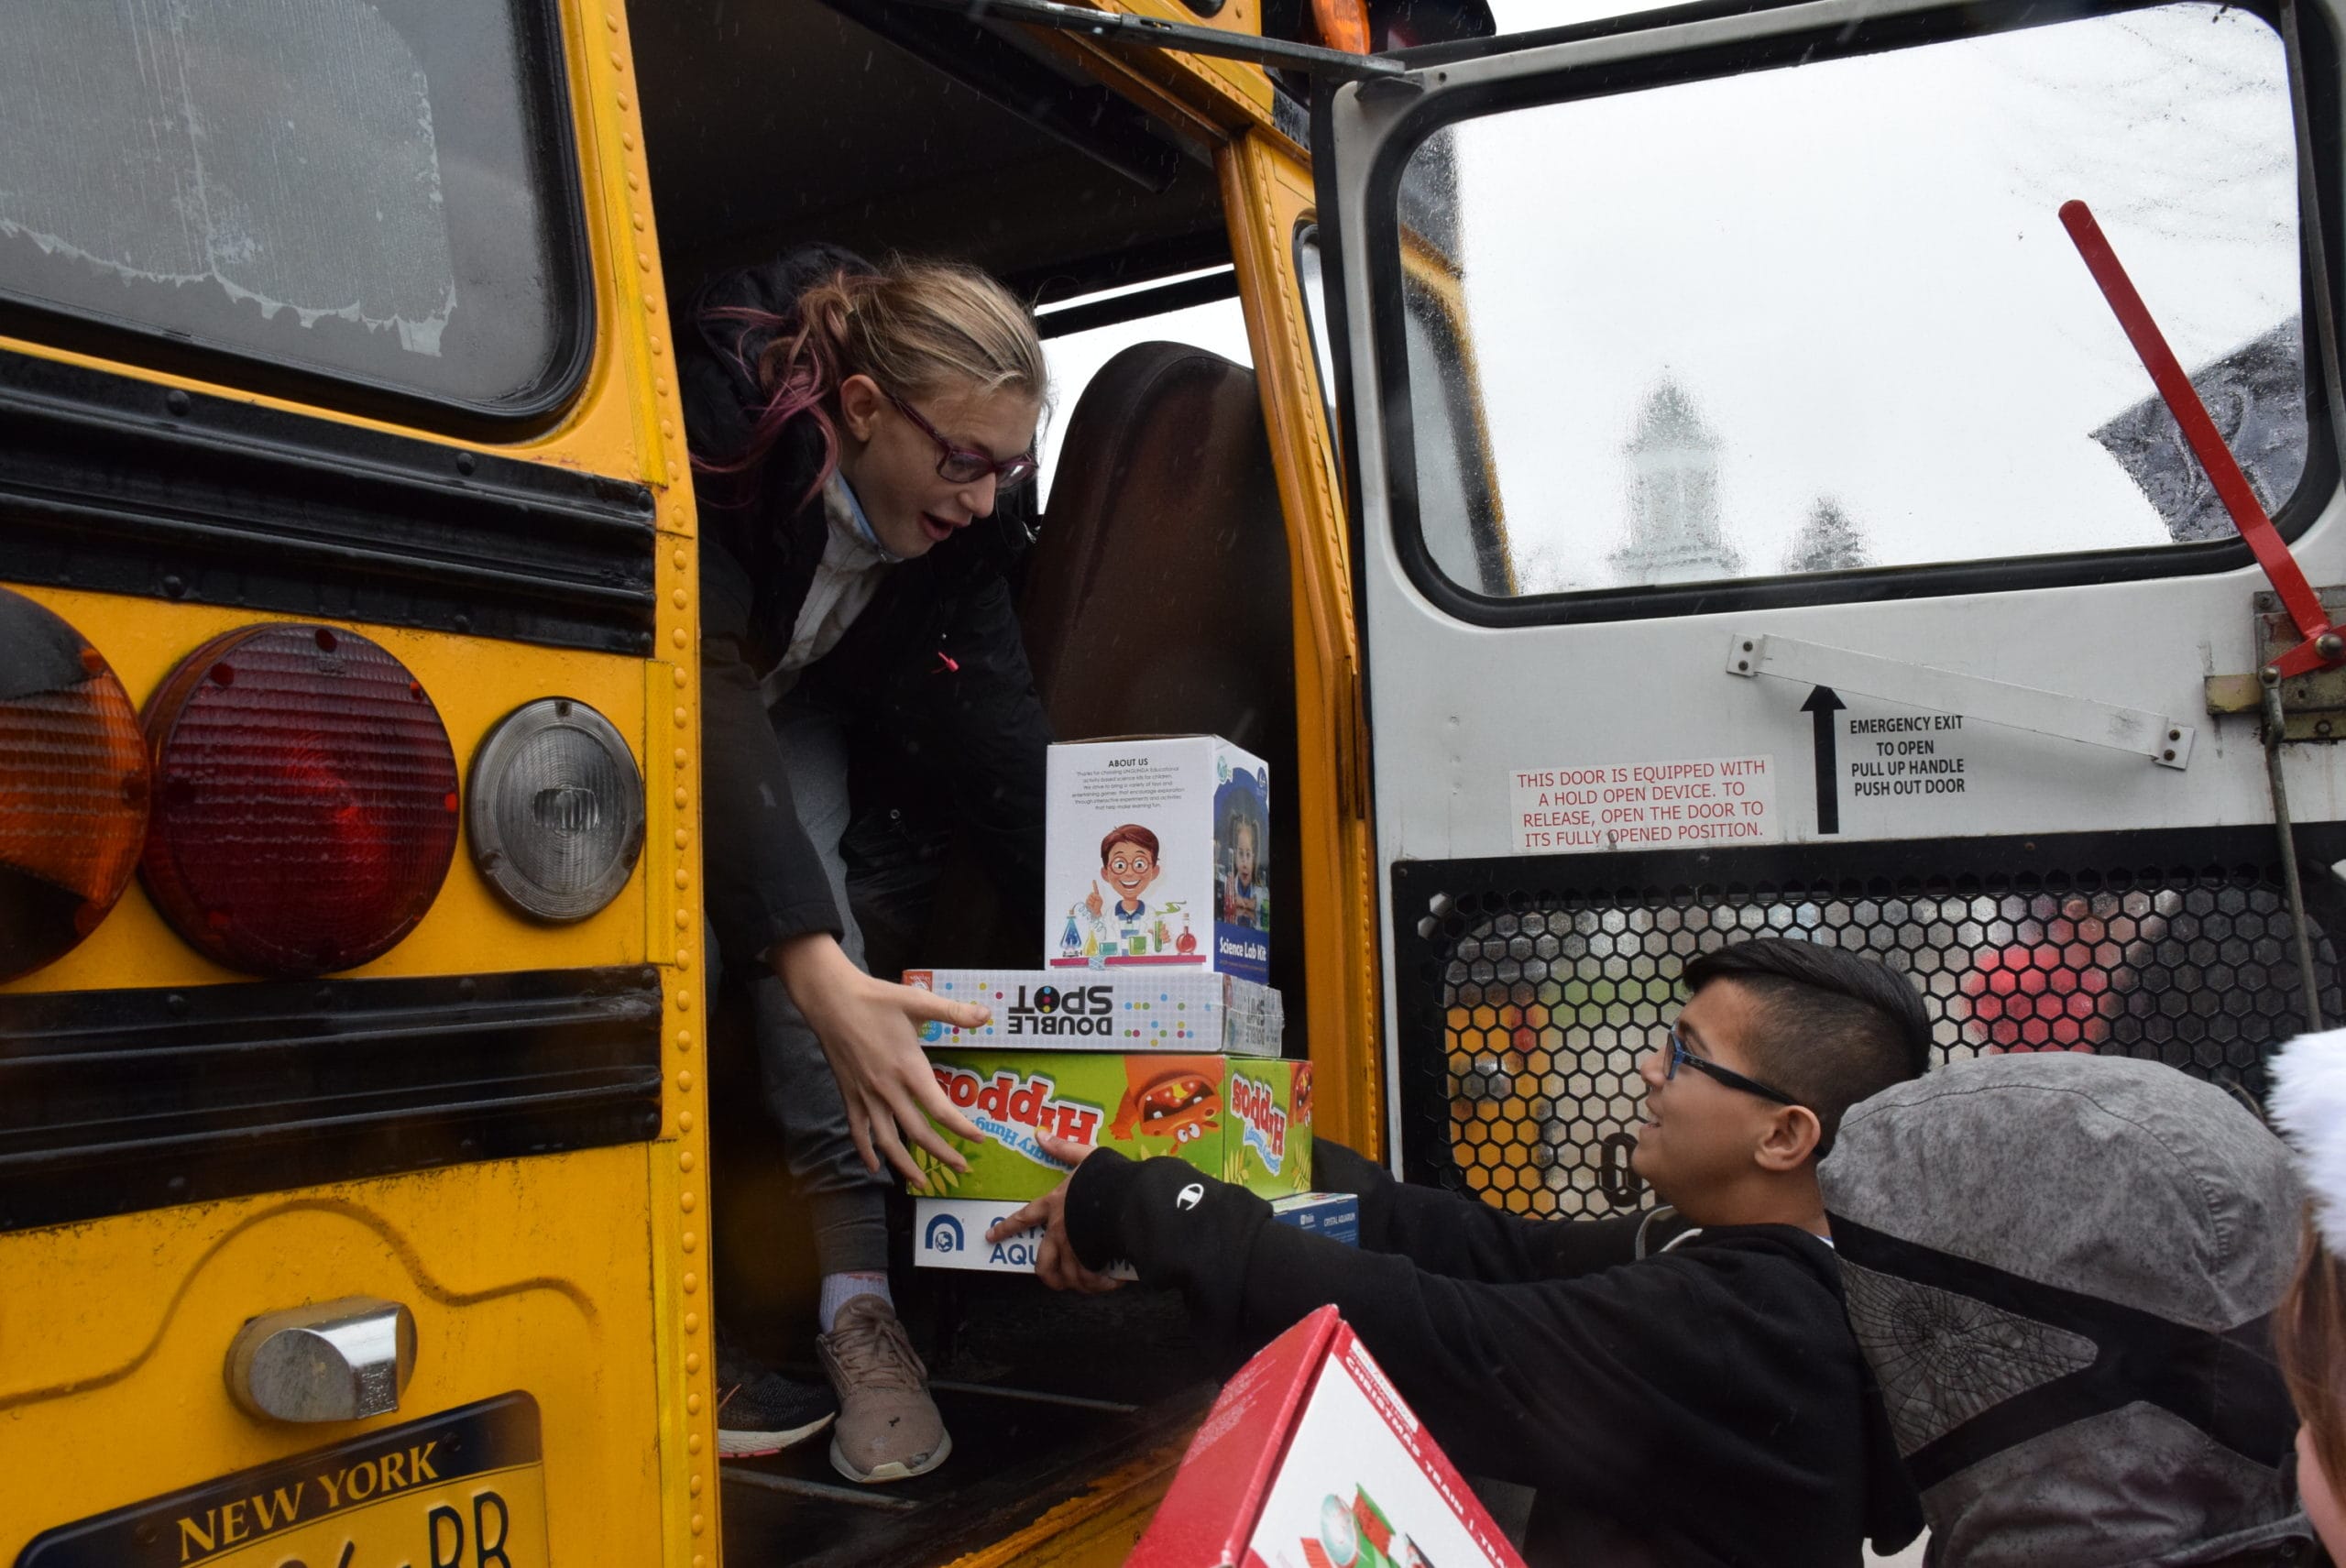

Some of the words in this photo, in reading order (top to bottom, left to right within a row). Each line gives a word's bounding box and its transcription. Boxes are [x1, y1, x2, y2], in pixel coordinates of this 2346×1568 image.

[1850, 717, 1931, 734] EMERGENCY
[1935, 715, 1963, 730] EXIT
[1876, 741, 1894, 756] TO
[1897, 740, 1935, 755] OPEN
[1108, 759, 1136, 768] ABOUT
[1138, 758, 1148, 766] US
[1517, 773, 1554, 788] THIS
[1560, 769, 1606, 785] DOOR
[1611, 768, 1628, 784] IS
[1633, 762, 1715, 784] EQUIPPED
[1720, 760, 1765, 776] WITH
[1851, 762, 1885, 777] PULL
[1888, 761, 1905, 776] UP
[1909, 759, 1965, 774] HANDLE
[1539, 793, 1549, 806] A
[1554, 790, 1598, 806] HOLD
[1603, 787, 1646, 804] OPEN
[1652, 784, 1716, 801] DEVICE.
[1722, 781, 1745, 796] TO
[1855, 782, 1890, 796] PUSH
[1893, 780, 1922, 795] OUT
[1925, 778, 1965, 794] DOOR
[1523, 810, 1595, 828] RELEASE,
[1601, 807, 1644, 824] OPEN
[1650, 806, 1681, 820] THE
[1688, 803, 1736, 818] DOOR
[1740, 801, 1764, 817] TO
[1525, 833, 1551, 848] ITS
[1557, 830, 1602, 846] FULLY
[1607, 827, 1672, 844] OPENED
[1678, 822, 1763, 840] POSITION.
[1220, 936, 1243, 958] Science
[1244, 941, 1256, 959] Lab
[1257, 944, 1266, 961] Kit
[1008, 985, 1113, 1015] SPOT
[1008, 1015, 1113, 1036] DOUBLE
[1345, 1355, 1421, 1458] CHRISTMAS
[1425, 1460, 1464, 1515] TRAIN
[177, 1482, 304, 1562] NEW
[317, 1441, 439, 1509] YORK
